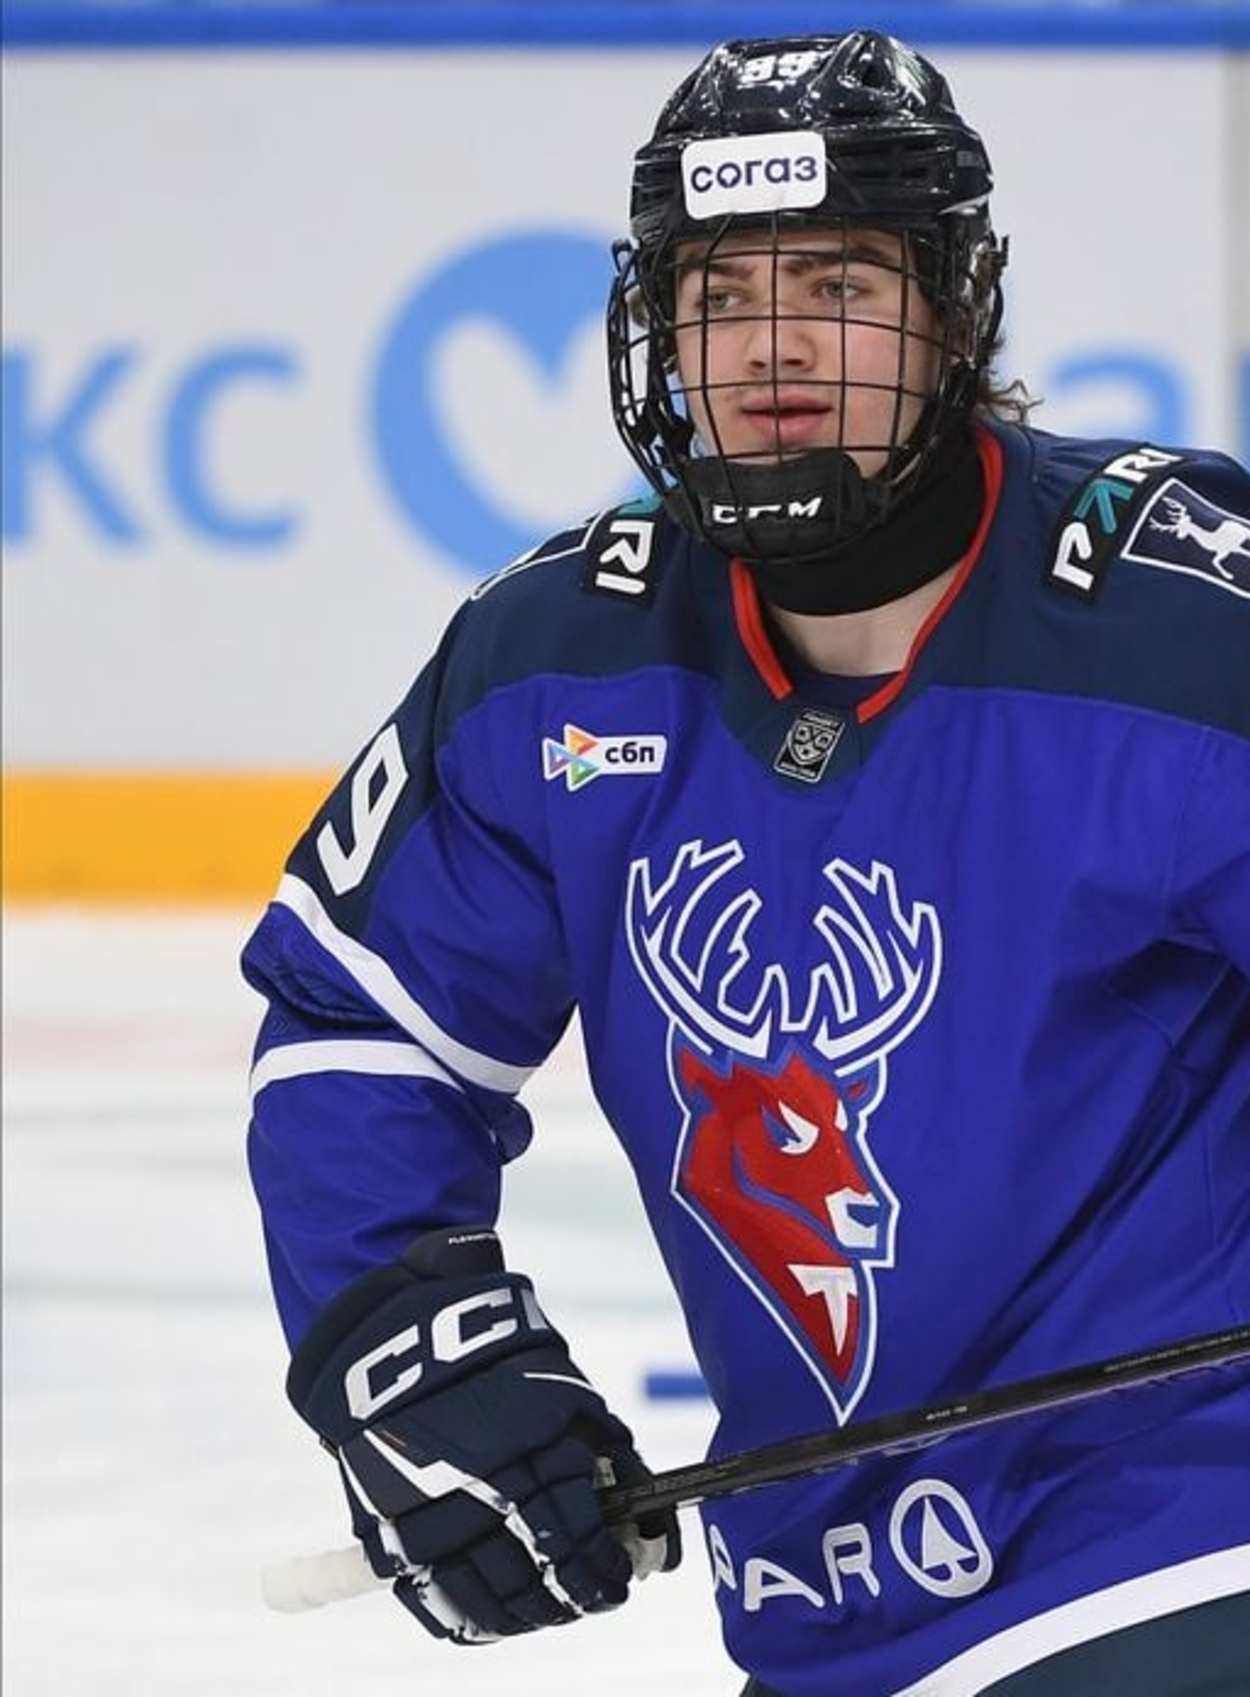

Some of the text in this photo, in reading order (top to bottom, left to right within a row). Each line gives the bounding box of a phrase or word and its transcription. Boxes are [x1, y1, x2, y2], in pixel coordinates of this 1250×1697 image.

[690, 155, 819, 193] согаз
[604, 740, 657, 764] сбп
[316, 722, 409, 896] 9
[345, 1287, 550, 1420] CC
